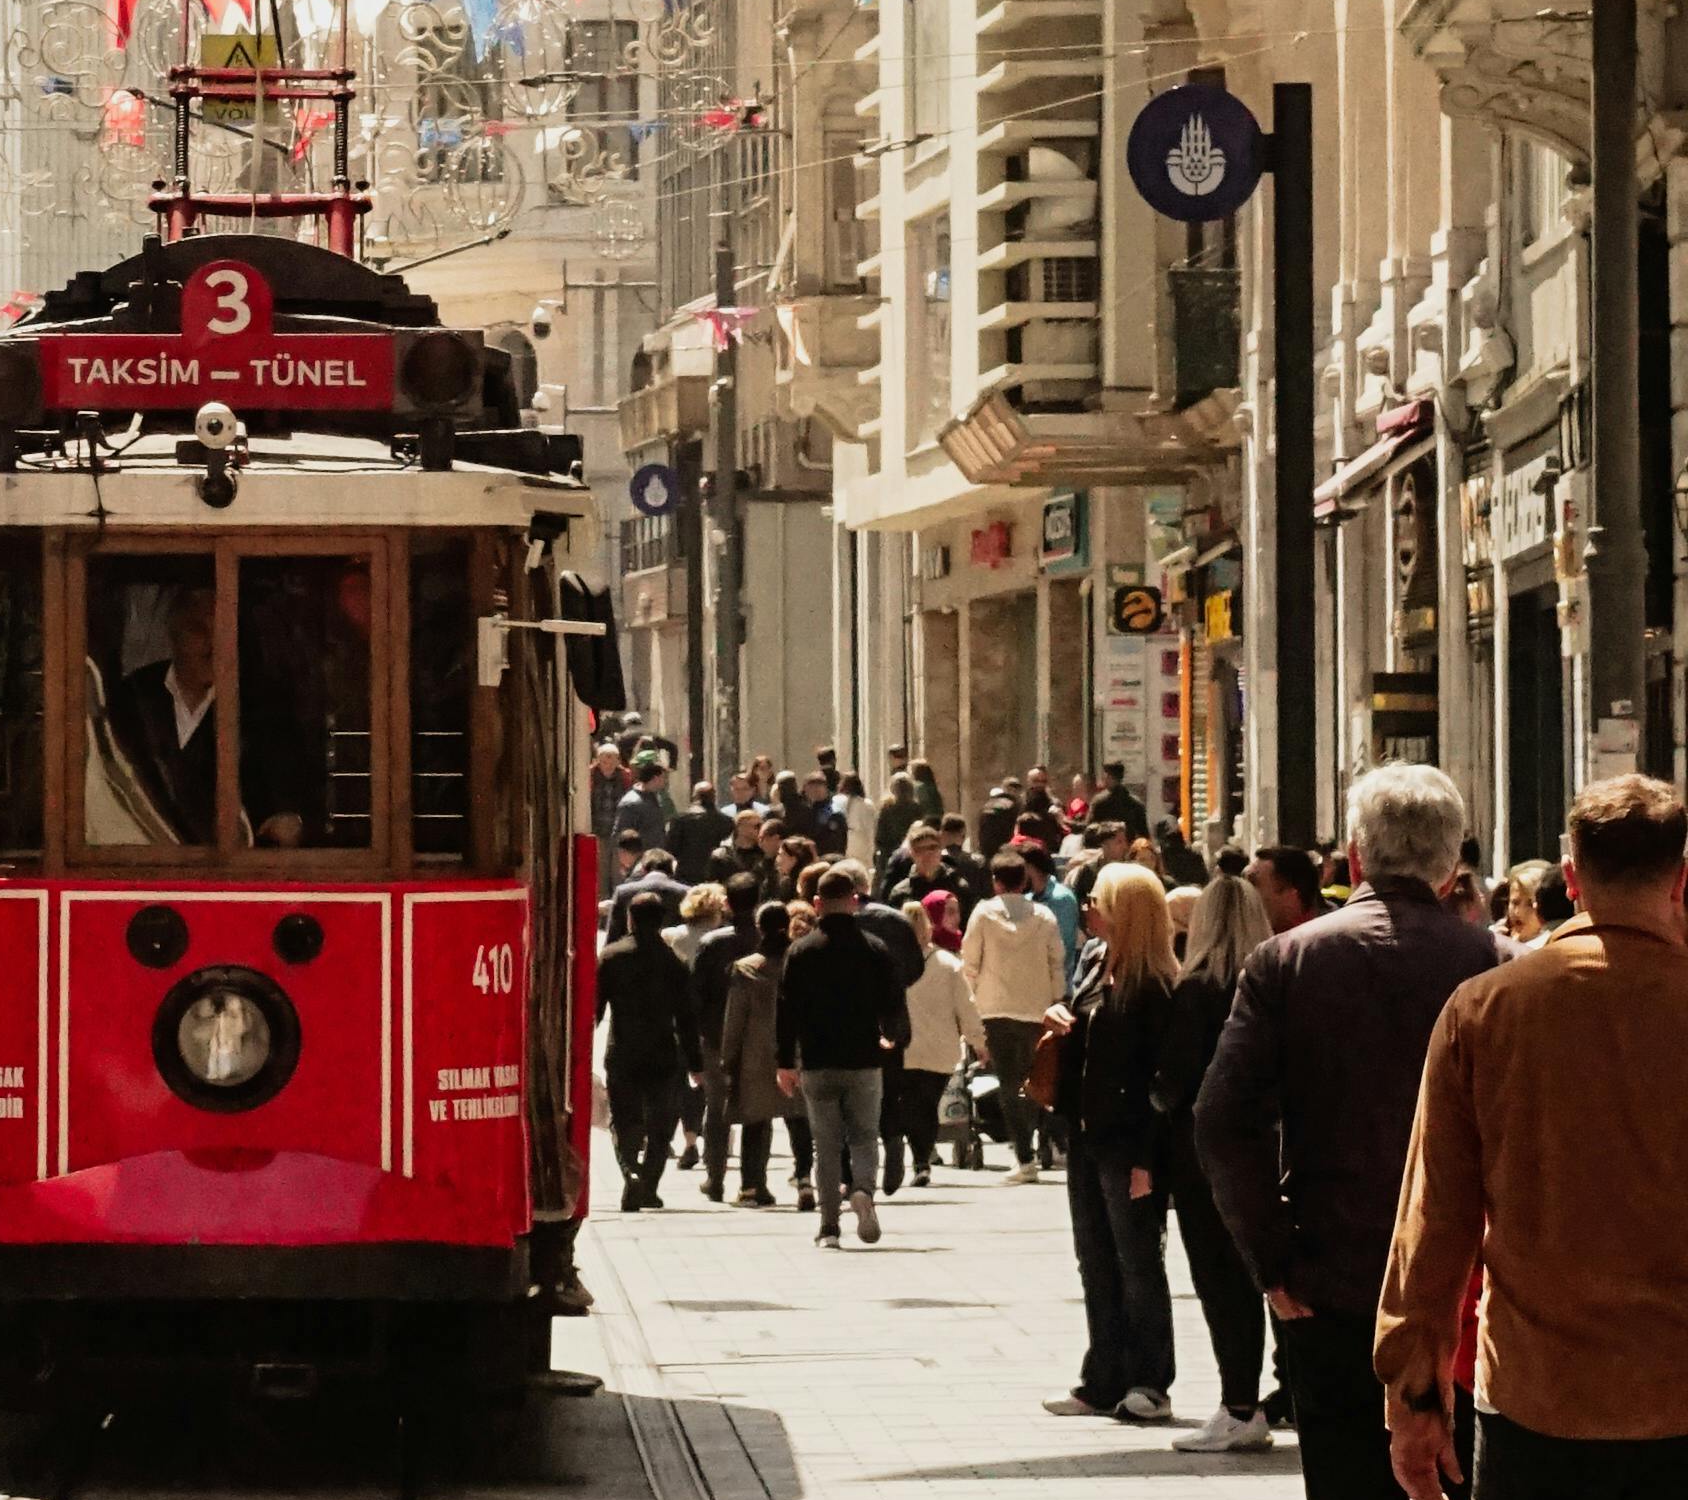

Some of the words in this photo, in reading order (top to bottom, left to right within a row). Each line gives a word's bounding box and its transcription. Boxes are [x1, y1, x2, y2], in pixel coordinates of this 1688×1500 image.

[205, 269, 251, 335] 3
[68, 350, 200, 386] TAKSİM
[250, 352, 366, 387] TÜNEL
[472, 943, 513, 995] 410
[429, 1099, 448, 1122] VE
